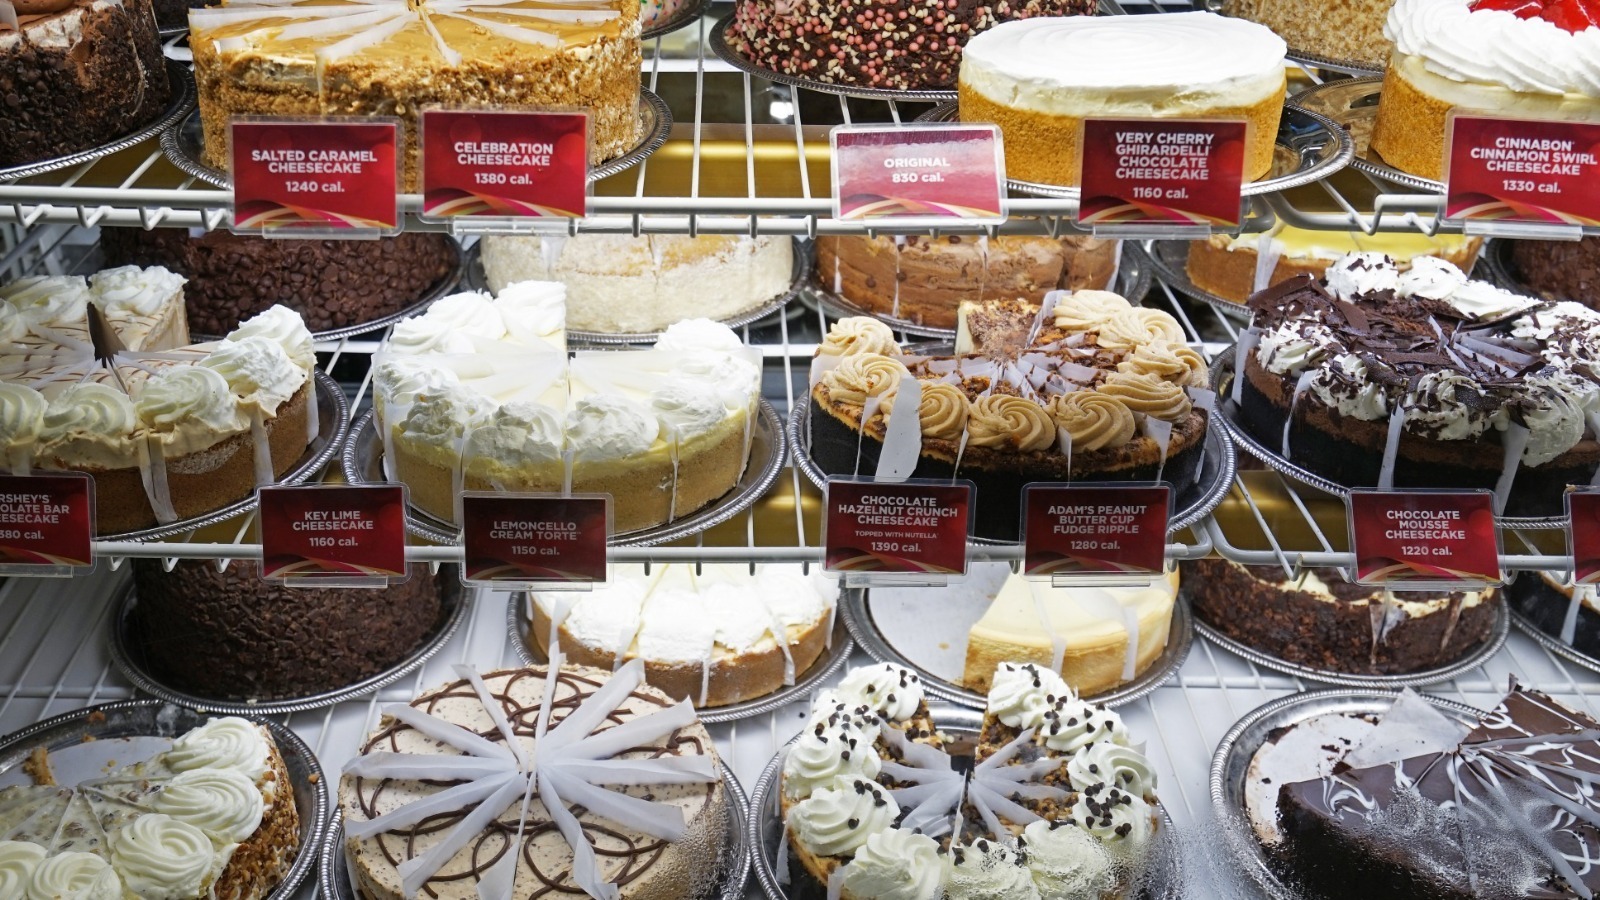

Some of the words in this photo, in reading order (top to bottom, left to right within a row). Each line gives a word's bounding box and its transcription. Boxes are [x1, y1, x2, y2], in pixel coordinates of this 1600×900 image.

[1115, 132, 1153, 144] VERY
[1156, 132, 1215, 145] CHERRY
[454, 141, 554, 155] CELEBRATION
[1495, 137, 1573, 152] CINNABON
[251, 149, 306, 162] SALTED
[308, 150, 378, 163] CARAMEL
[1115, 144, 1210, 157] GHIRARDELLI
[1470, 147, 1550, 162] CINNAMON
[1552, 152, 1598, 165] SWIRL
[457, 153, 551, 166] CHEESECAKE
[884, 157, 950, 167] ORIGINAL
[1119, 156, 1207, 168] CHOCOLATE
[269, 162, 361, 173] CHEESECAKE
[1486, 161, 1581, 176] CHEESECAKE
[475, 173, 506, 184] 1380
[509, 174, 533, 185] cal.
[892, 173, 918, 183] 830
[921, 173, 945, 183] cal.
[1115, 167, 1209, 180] CHEESECAKE
[286, 181, 318, 192] 1240
[321, 181, 345, 193] cal.
[1502, 179, 1535, 192] 1330
[1537, 182, 1562, 194] cal.
[1133, 187, 1163, 198] 1160
[1165, 188, 1189, 199] cal.
[860, 495, 937, 507] CHOCOLATE
[43, 504, 70, 514] BAR
[838, 504, 904, 516] HAZELNUT
[906, 507, 958, 518] CRUNCH
[1047, 505, 1095, 515] ADAM'S
[1097, 505, 1147, 515] PEANUT
[0, 513, 60, 524] ESECAKE
[304, 511, 330, 521] KEY
[331, 510, 361, 520] LIME
[1059, 515, 1107, 525] BUTTER
[1109, 515, 1135, 525] CUP
[1386, 510, 1461, 520] CHOCOLATE
[292, 519, 374, 531] CHEESECAKE
[493, 521, 577, 531] LEMONCELLO
[857, 515, 939, 527] CHEESECAKE
[1398, 520, 1450, 530] MOUSSE
[1053, 525, 1095, 534] FUDGE
[1097, 524, 1140, 534] RIPPLE
[1385, 529, 1466, 540] CHEESECAKE
[23, 530, 45, 540] cal.
[489, 530, 533, 540] CREAM
[536, 530, 577, 541] TORTE
[309, 536, 336, 547] 1160
[338, 537, 359, 547] cal.
[871, 541, 899, 552] 1390
[901, 542, 922, 552] cal.
[1070, 540, 1098, 550] 1280
[1100, 541, 1121, 550] cal.
[511, 545, 537, 555] 1150
[539, 547, 560, 556] cal.
[1401, 545, 1429, 556] 1220
[1431, 546, 1453, 556] cal.
